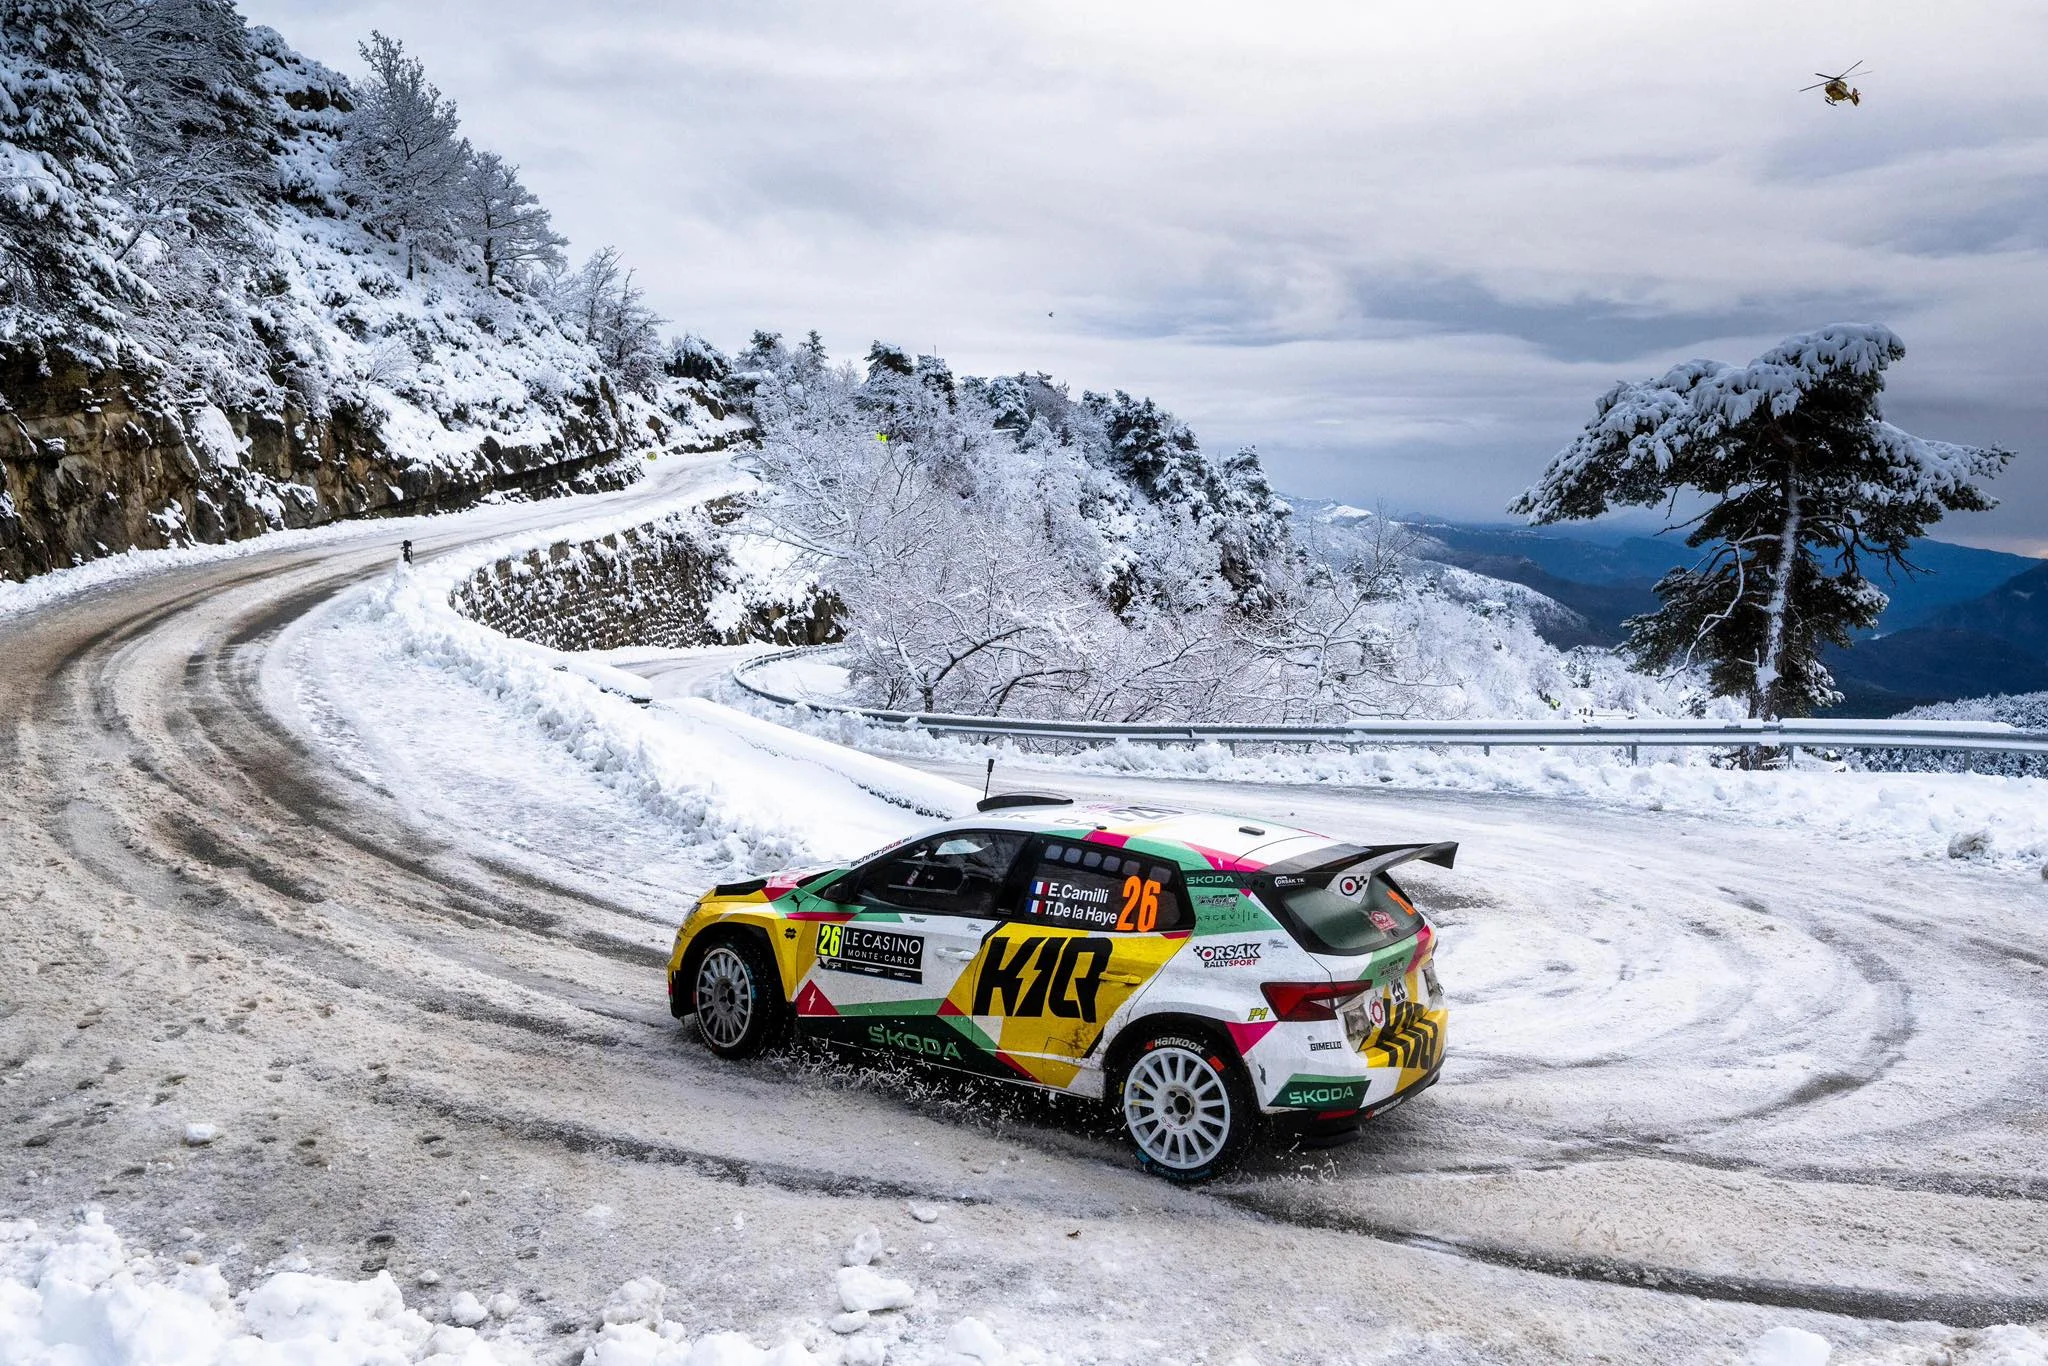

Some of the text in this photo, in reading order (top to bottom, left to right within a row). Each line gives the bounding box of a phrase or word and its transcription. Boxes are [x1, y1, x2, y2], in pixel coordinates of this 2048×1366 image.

[1047, 882, 1109, 904] E.Camilli
[1115, 875, 1161, 932] 26
[1045, 900, 1118, 926] T.De la Haye
[818, 925, 842, 957] 26
[844, 931, 921, 955] LE CASINO
[1204, 959, 1257, 968] RALLYSPORT
[1310, 1041, 1342, 1052] GIMELLO
